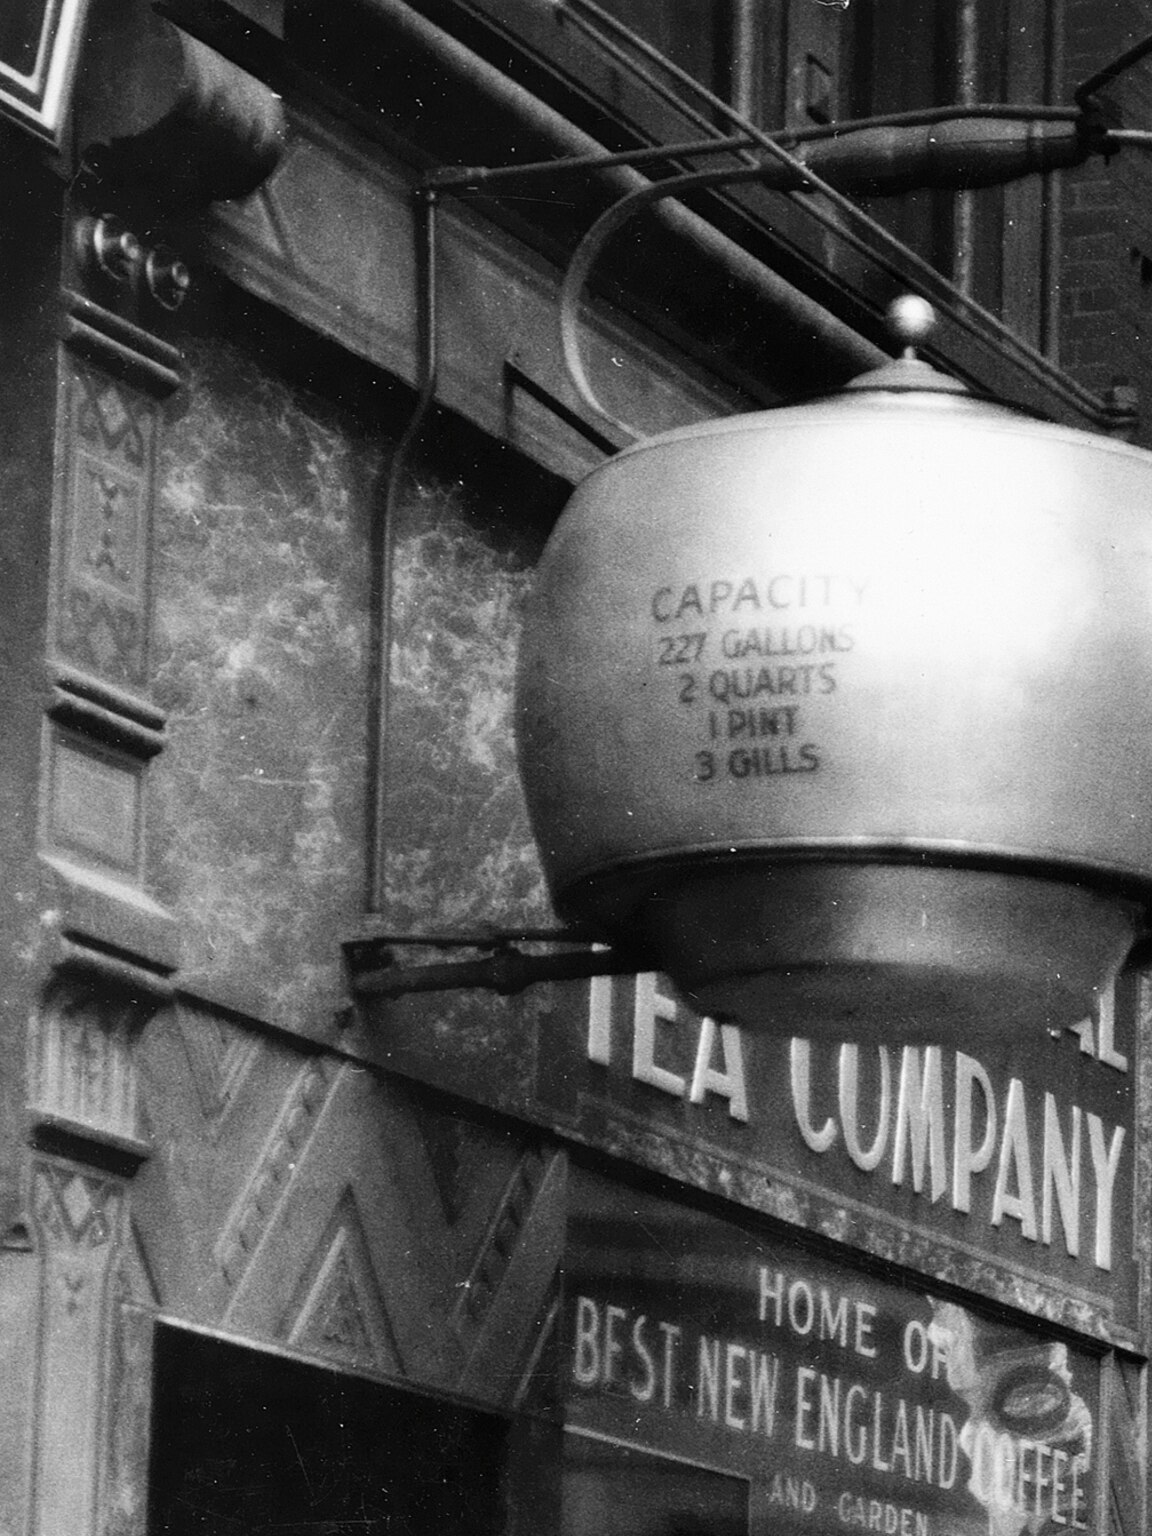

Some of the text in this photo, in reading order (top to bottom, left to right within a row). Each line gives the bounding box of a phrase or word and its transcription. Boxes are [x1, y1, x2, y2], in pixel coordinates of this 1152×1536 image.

[650, 573, 868, 623] CAPACITY
[658, 623, 855, 666] 227 GALLONS
[679, 662, 837, 704] 2 QUARTS
[728, 705, 798, 738] PINT
[695, 744, 822, 781] 3 GILLS
[790, 1036, 1126, 1271] COMPANY
[759, 1266, 877, 1358] HOME
[575, 1297, 681, 1408] BEST
[697, 1336, 779, 1437] NEW
[795, 1366, 957, 1490] ENGLAND
[768, 1474, 817, 1512] AND
